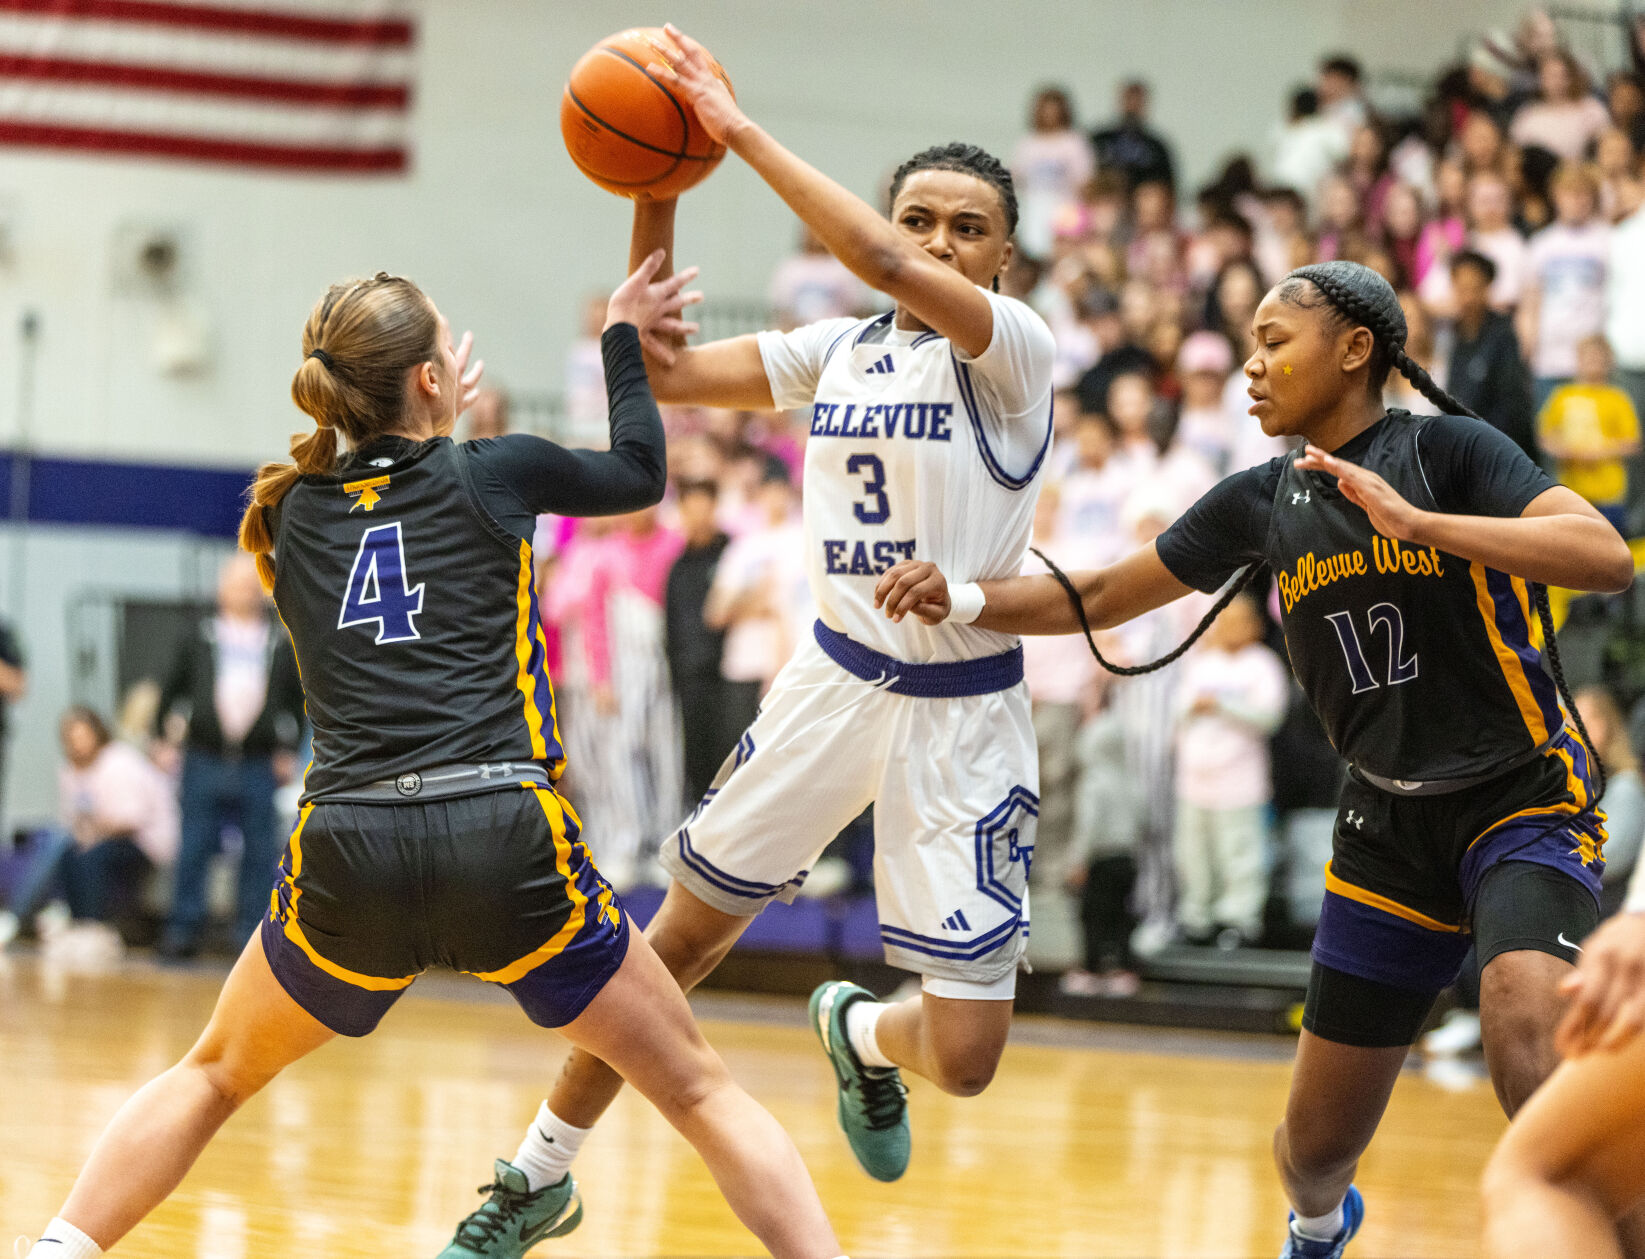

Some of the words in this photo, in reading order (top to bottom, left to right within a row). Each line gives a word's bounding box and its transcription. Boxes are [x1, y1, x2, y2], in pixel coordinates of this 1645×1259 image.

[810, 402, 954, 442] ELLEVUE
[846, 452, 892, 526] 3
[337, 521, 426, 646] 4
[1279, 551, 1368, 615] Bellevue
[1372, 535, 1445, 578] West
[1323, 602, 1419, 695] 12
